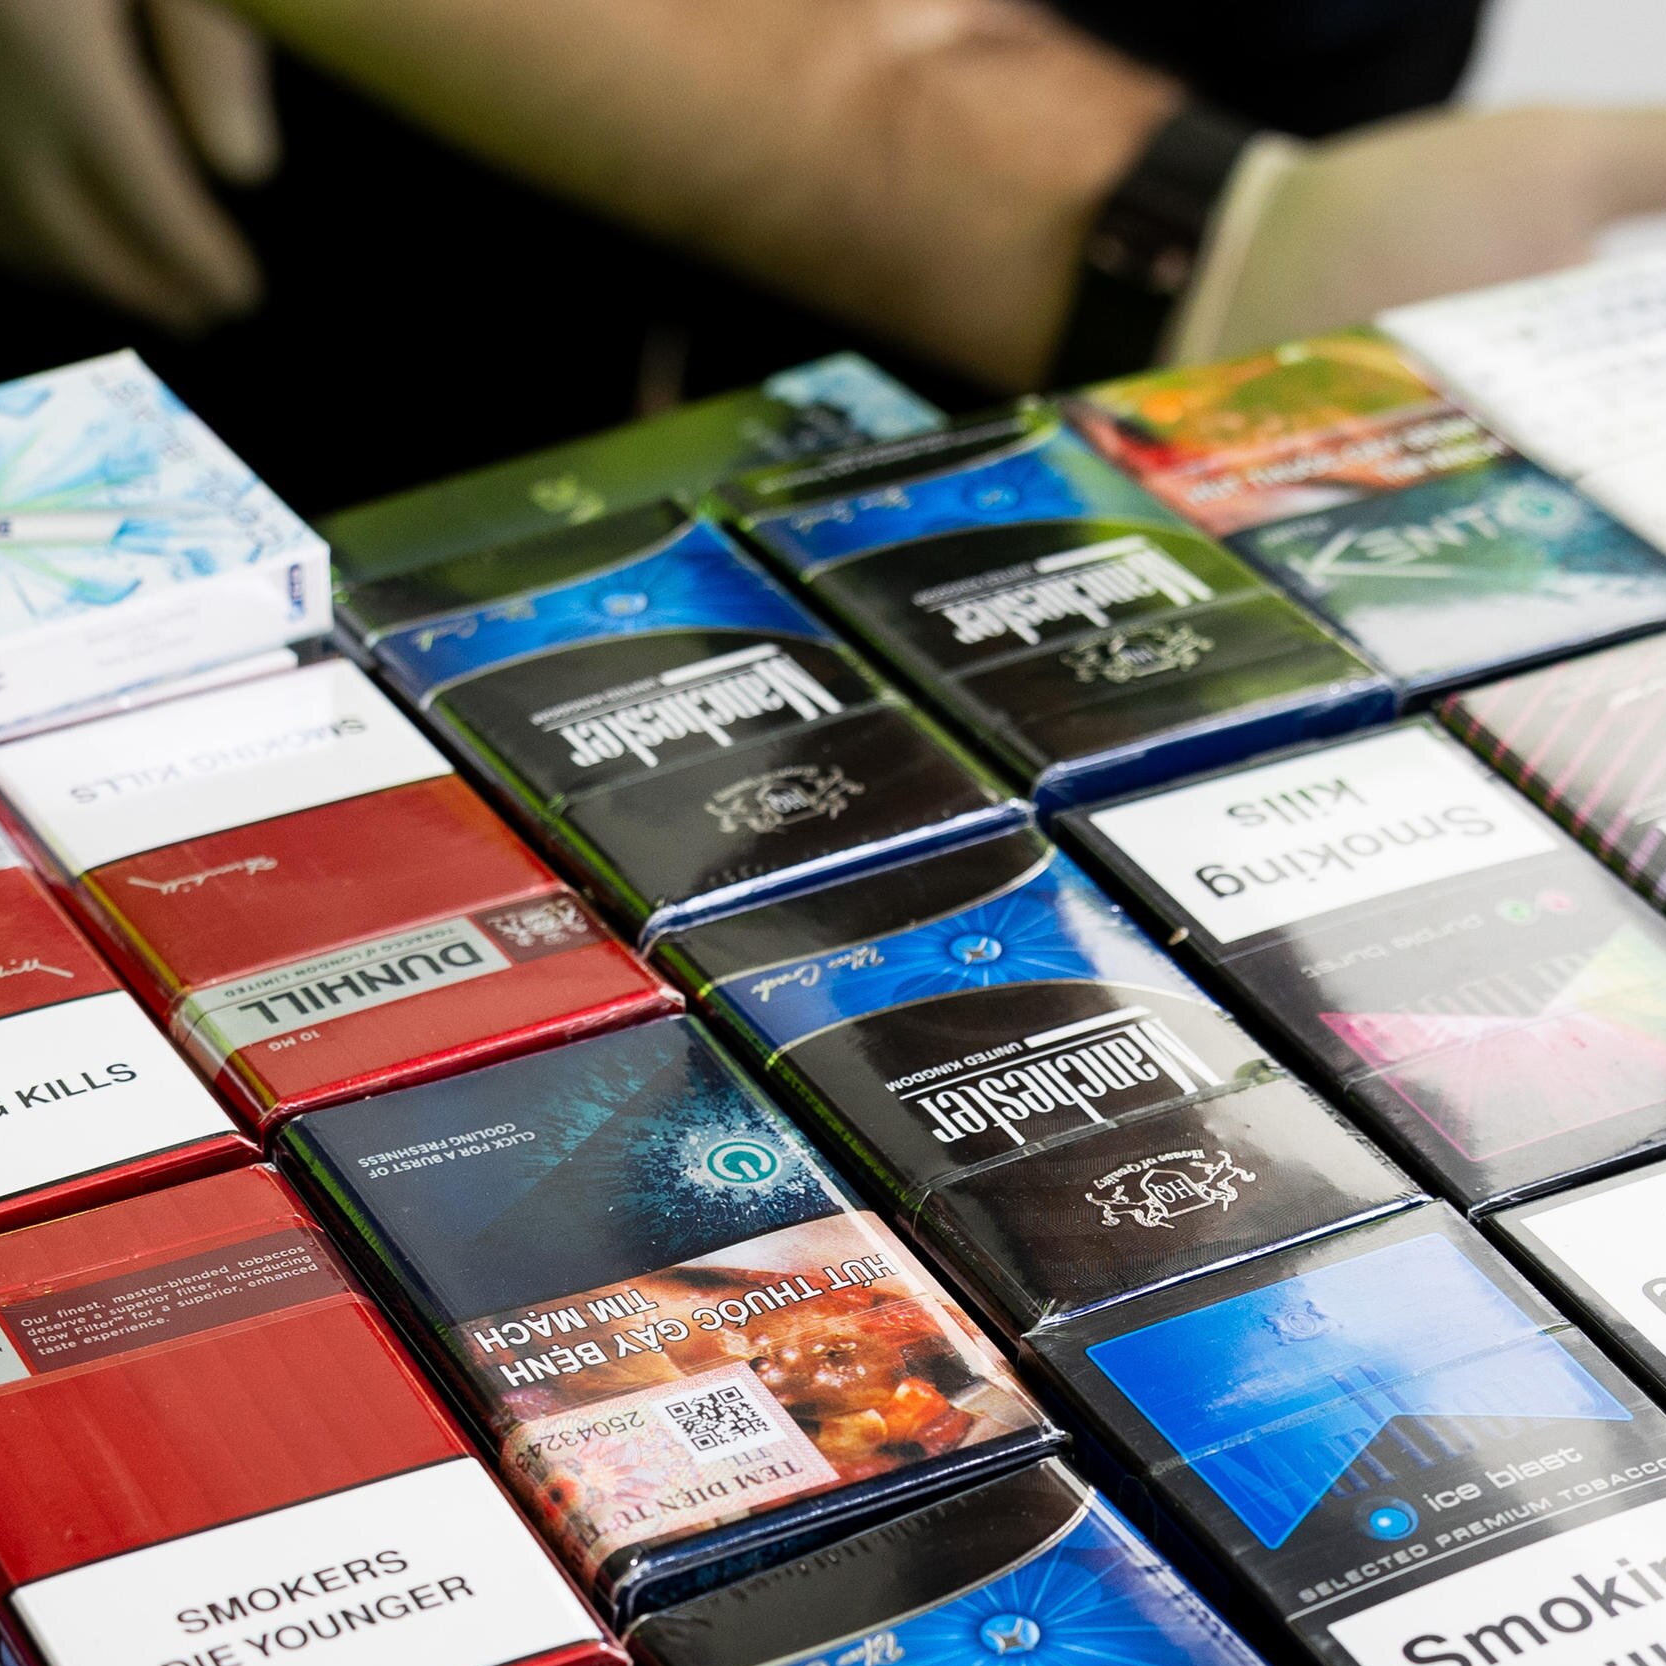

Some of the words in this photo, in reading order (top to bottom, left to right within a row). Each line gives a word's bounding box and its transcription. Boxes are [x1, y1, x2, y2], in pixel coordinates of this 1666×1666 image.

[943, 541, 1214, 646] Manchester
[560, 652, 845, 769] Manchester
[190, 717, 367, 772] SMOKING
[70, 763, 183, 804] KILLS
[1226, 775, 1357, 833] kills
[1194, 803, 1499, 902] Smoking
[381, 925, 456, 952] TOBACCO
[237, 941, 485, 1025] DUNHILL
[294, 950, 361, 976] LONDON
[223, 972, 290, 998] LIMITED
[267, 1037, 297, 1052] MG
[299, 1029, 322, 1042] 10
[962, 1040, 1023, 1068] UNITED
[17, 1061, 140, 1110] KILLS
[884, 1057, 965, 1093] KINGDOM
[917, 1017, 1227, 1147] Manchester
[357, 1139, 449, 1168] FRESHNESS
[449, 1122, 517, 1147] COOLING
[458, 1142, 491, 1158] FOR
[493, 1131, 536, 1150] CLICK
[1156, 1147, 1206, 1163] House
[368, 1167, 390, 1180] OF
[391, 1153, 444, 1174] BURST
[444, 1151, 456, 1161] A
[1152, 1175, 1195, 1206] HQ
[20, 1312, 50, 1329] Our
[56, 1300, 106, 1321] finest,
[111, 1264, 230, 1304] master-blended
[237, 1243, 306, 1270] tobaccos
[822, 1250, 899, 1291] HÚT
[26, 1319, 88, 1338] deserve
[107, 1292, 171, 1319] superior
[175, 1279, 217, 1301] filter.
[225, 1252, 313, 1286] Introducing
[31, 1330, 71, 1347] Flow
[131, 1306, 154, 1323] for
[176, 1283, 243, 1312] superior,
[247, 1261, 319, 1289] enhanced
[583, 1288, 659, 1328] TIM
[692, 1268, 821, 1333] THUỐC
[36, 1338, 78, 1357] taste
[82, 1316, 171, 1347] experience.
[473, 1304, 582, 1357] MẠCH
[605, 1303, 690, 1359] GÂY
[500, 1332, 604, 1388] BỆNH
[735, 1459, 804, 1491] TEM
[1422, 1477, 1482, 1513] ice
[1484, 1444, 1584, 1490] blast
[1298, 1540, 1430, 1606] SELECTED
[1435, 1496, 1553, 1549] PREMIUM
[175, 1548, 410, 1637] SMOKERS
[241, 1574, 477, 1660] YOUNGER
